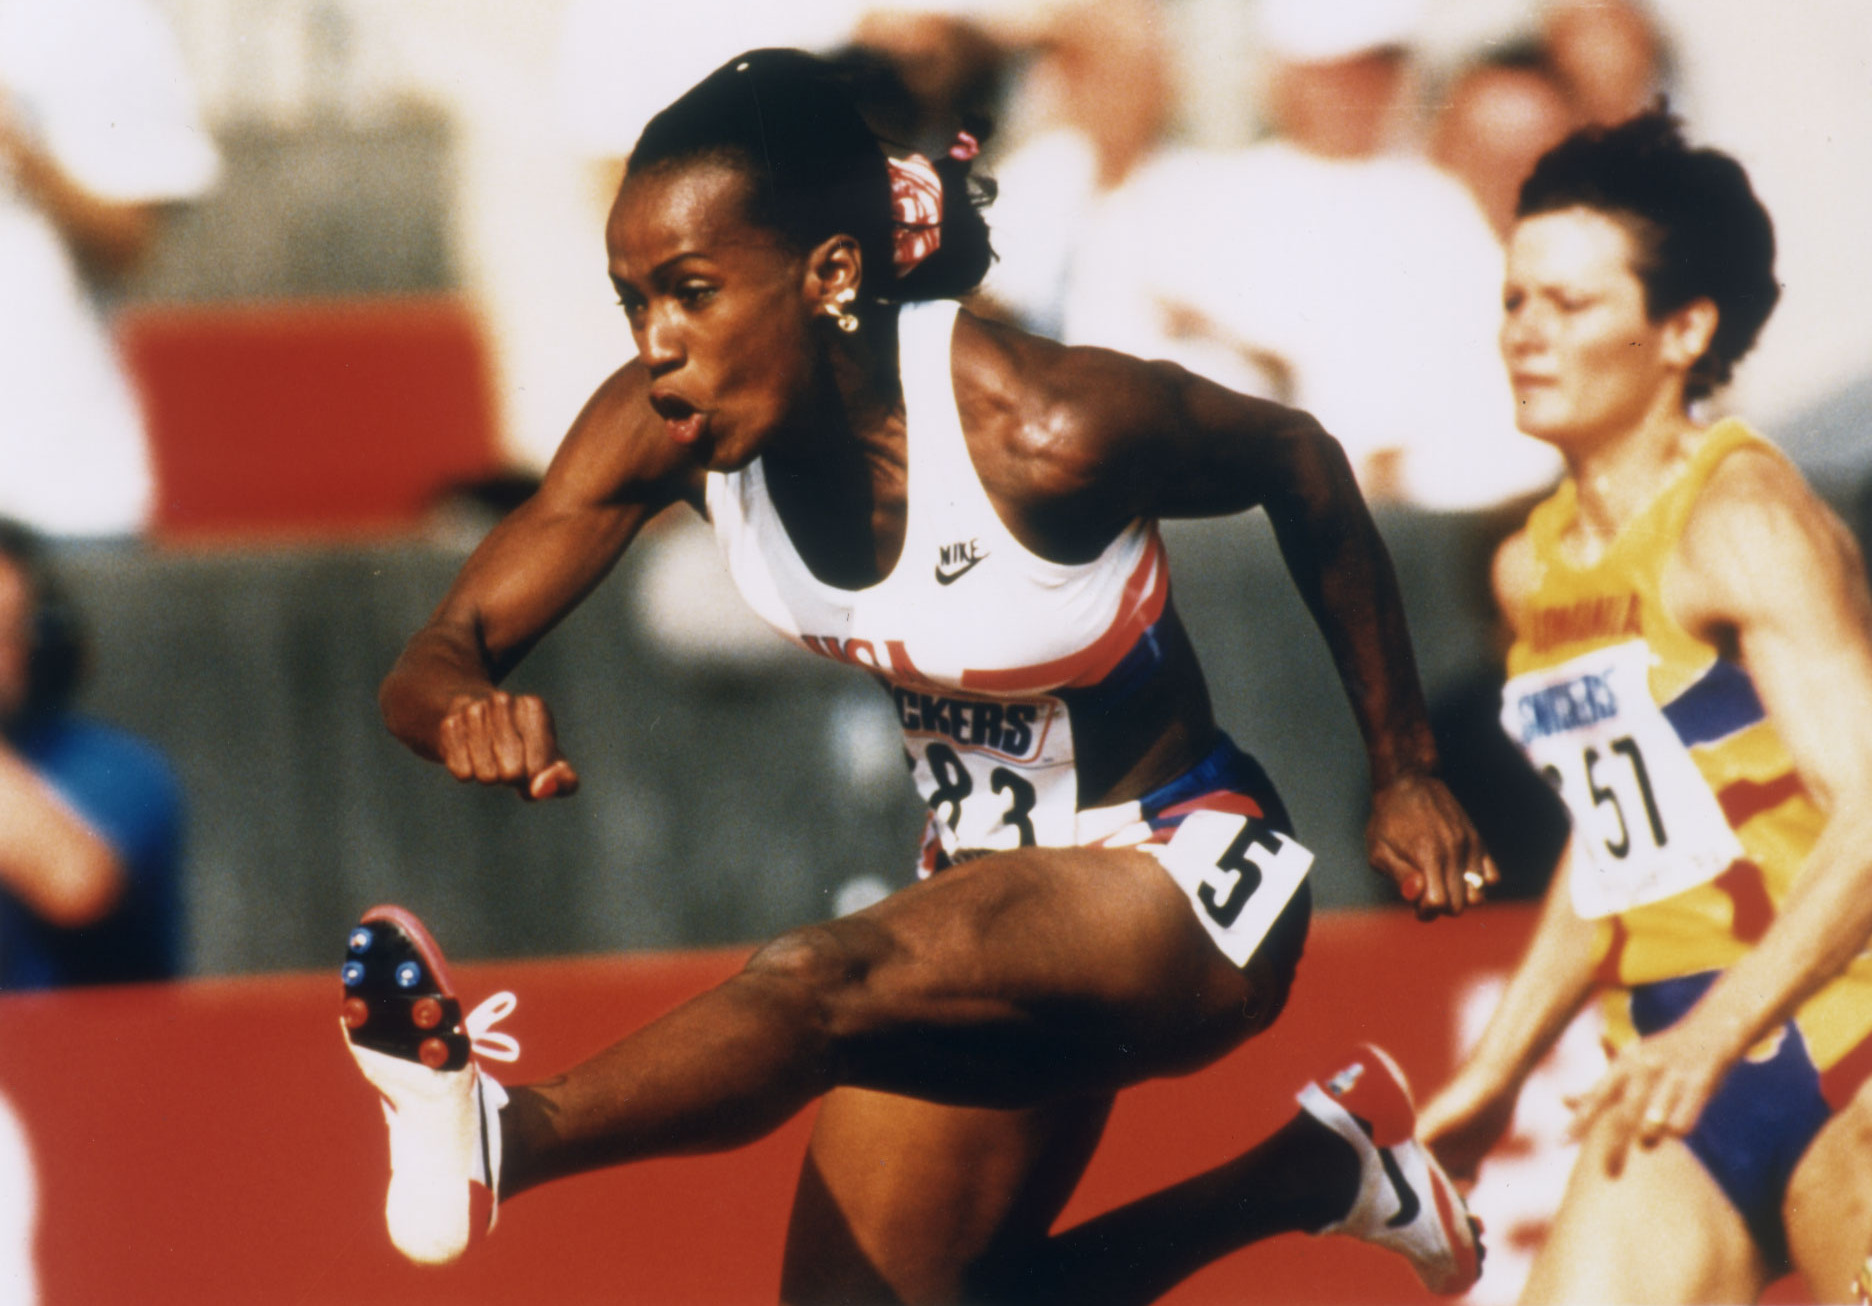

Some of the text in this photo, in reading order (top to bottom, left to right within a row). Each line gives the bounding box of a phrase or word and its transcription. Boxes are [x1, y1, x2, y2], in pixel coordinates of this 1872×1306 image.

[939, 537, 979, 566] NIKE
[905, 743, 1037, 847] 83
[1197, 818, 1284, 930] 5
